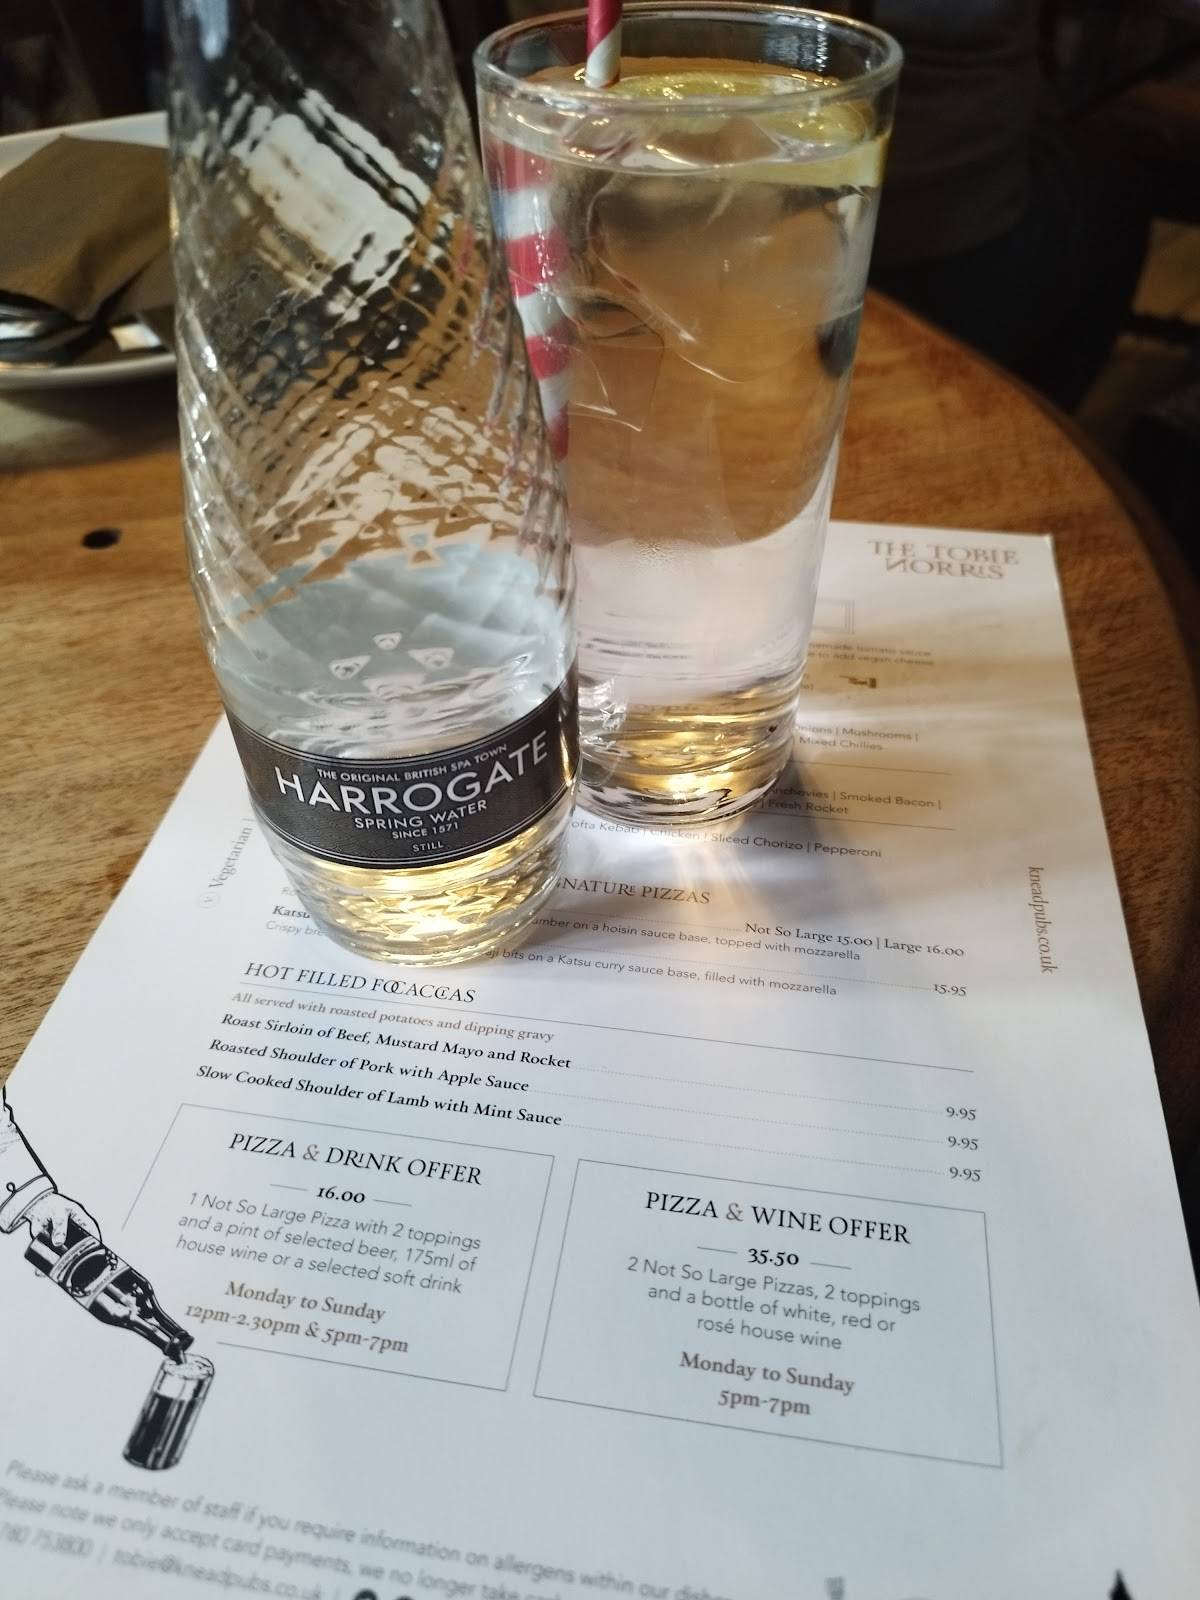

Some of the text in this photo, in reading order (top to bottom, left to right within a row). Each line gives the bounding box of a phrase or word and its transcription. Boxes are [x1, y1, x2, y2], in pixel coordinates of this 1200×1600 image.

[926, 544, 1020, 565] TOBIE
[800, 736, 883, 750] Mixed Chillies
[842, 727, 912, 740] Mushrooms
[274, 730, 548, 816] HARROGATE
[316, 743, 508, 783] THE ORIGINAL BRITISH SPA TOWN
[355, 799, 488, 829] SPRING WATER
[768, 800, 849, 814] Fresh Rocket
[840, 791, 891, 804] Smoked
[895, 796, 935, 807] Bacon
[392, 822, 459, 840] SINCE 1571
[412, 841, 444, 852] STILL
[571, 820, 882, 857] ofta Kebab Chicken Sliced Chorizo Pepperoni
[208, 826, 253, 888] Vegetarian
[557, 877, 711, 904] NATURE PIZZAS
[745, 922, 964, 957] Not So Large 15.00 Large 16.00
[1027, 866, 1059, 973] kneadpubs.co.uk
[265, 920, 837, 995] Crispy bits Katsu curry sauce base, filled with mozzarella
[602, 922, 638, 936] hoisin
[641, 928, 676, 940] sauce
[715, 936, 761, 951] topped
[764, 941, 791, 953] with
[794, 946, 860, 960] mozzarella
[244, 962, 476, 1003] HOT FILLED FOCACCIAS
[933, 982, 967, 996] 15.95
[232, 992, 555, 1044] All served with roasted potatoes and dipping gravy
[221, 1013, 976, 1121] Roast Sirloin of Beef, Mustard Mayo and Rocket 9.95
[208, 1038, 979, 1150] Roasted Shoulder of Pork with Apple Sauce 9.95
[196, 1065, 981, 1182] Slow Cooked Shoulder of Lamb with Mint Sauce 9.95
[228, 1133, 483, 1185] PIZZA & DRINK OFFER
[316, 1186, 366, 1204] 16.00
[201, 1193, 481, 1251] Not So Large Pizza with 2 toppings
[645, 1191, 911, 1244] PIZZA & WINE OFFER
[178, 1214, 478, 1273] and pint of selected beer, 175ml of
[747, 1248, 800, 1267] 35.50
[176, 1235, 463, 1294] house wine or selected soft drink
[627, 1256, 921, 1314] 2 Not So Large Pizzas, 2 toppings
[224, 1281, 386, 1323] Monday to Sunday
[647, 1286, 896, 1333] and bottle of white, red or
[185, 1305, 409, 1353] 12pm-2.30pm & 5pm-7pm
[697, 1316, 843, 1350] rosé house wine
[679, 1351, 856, 1396] Monday to Sunday
[717, 1389, 811, 1416] 5pm-7pm
[6, 1459, 634, 1594] Please member you require information allergens within
